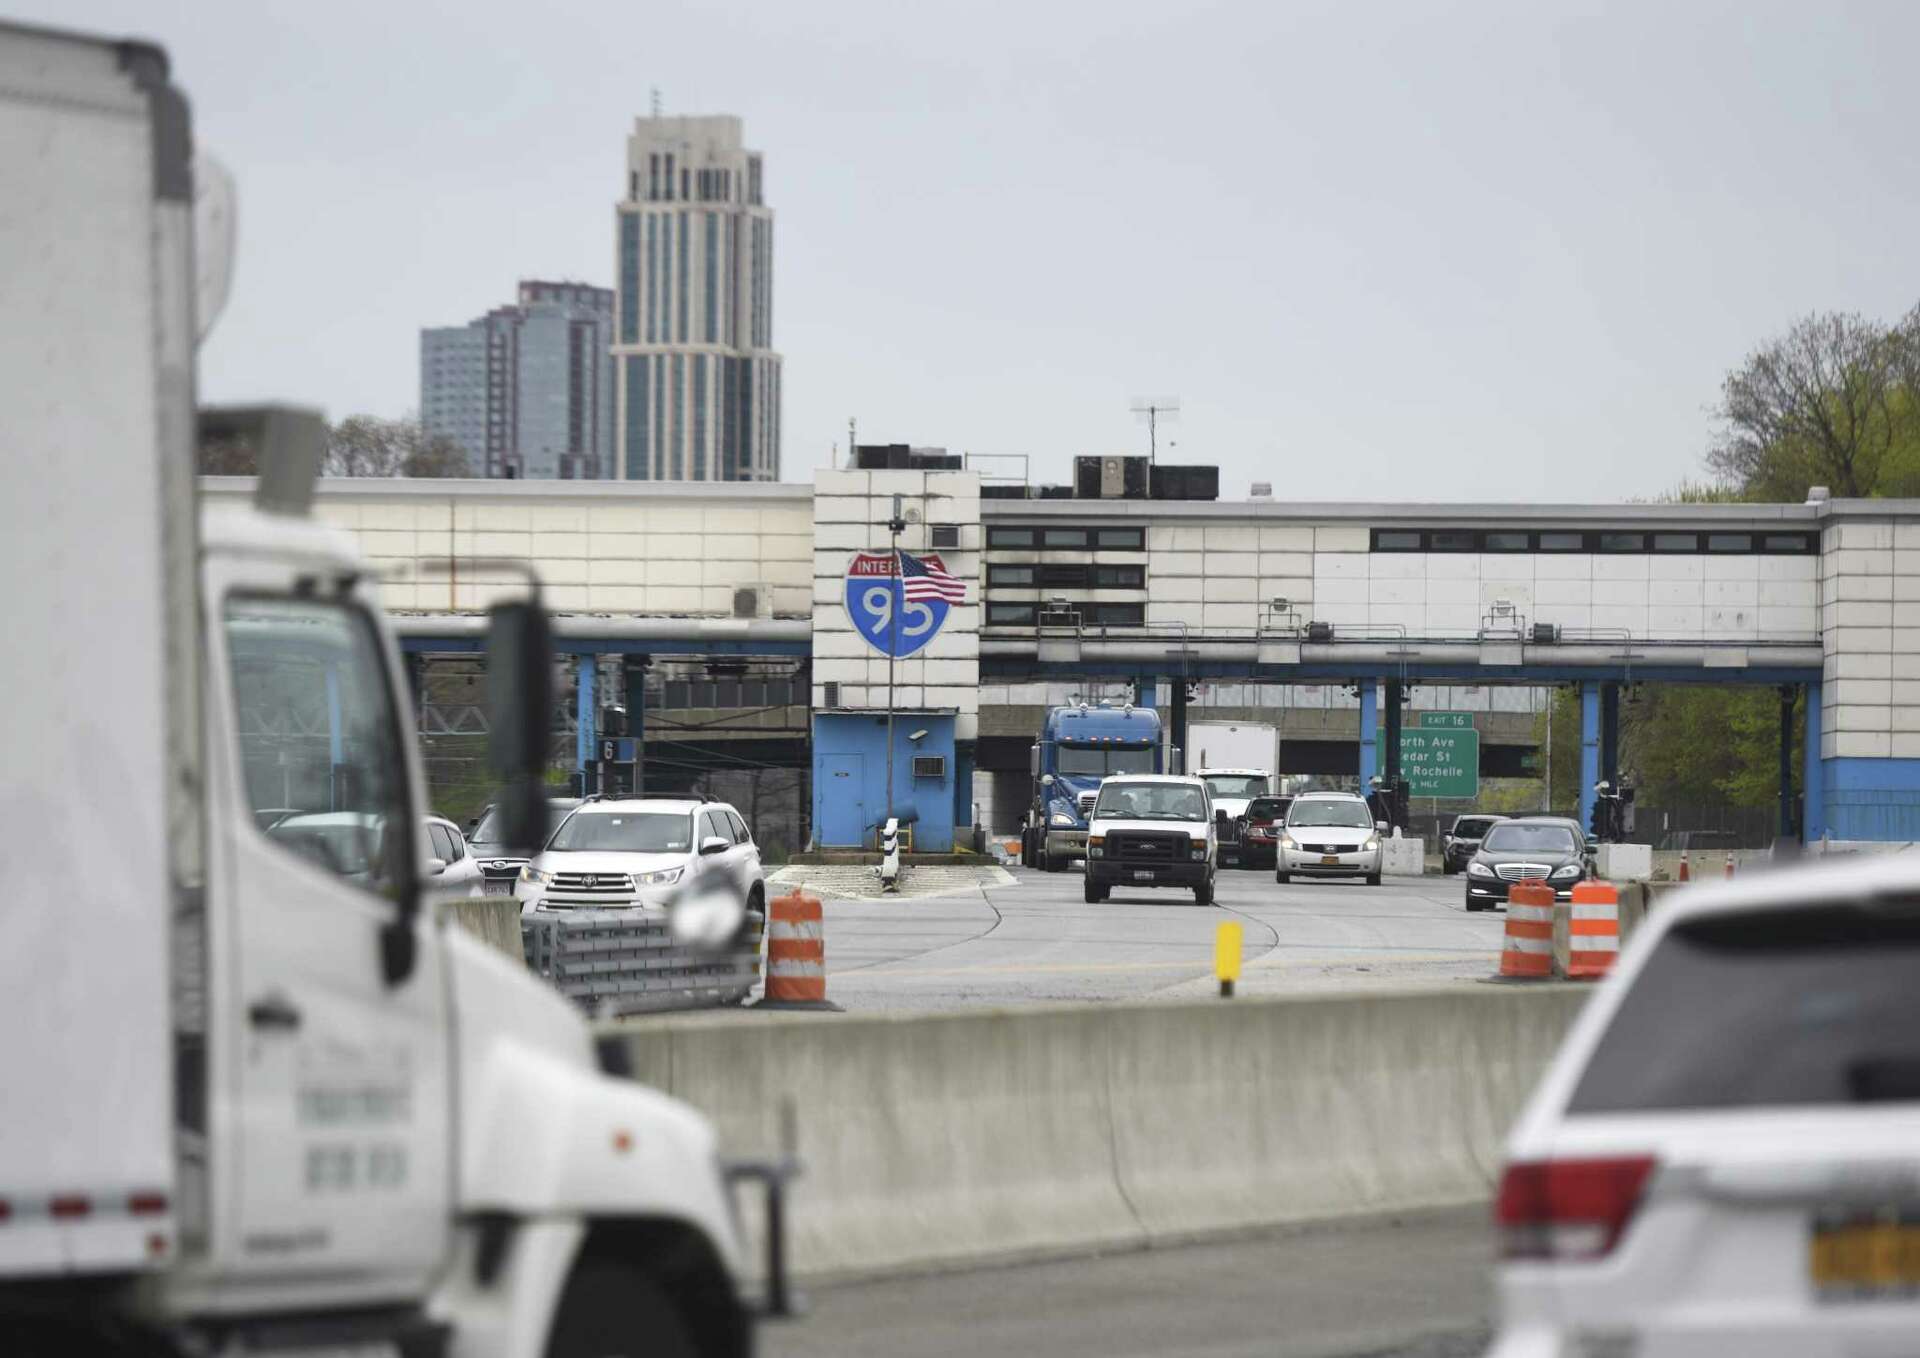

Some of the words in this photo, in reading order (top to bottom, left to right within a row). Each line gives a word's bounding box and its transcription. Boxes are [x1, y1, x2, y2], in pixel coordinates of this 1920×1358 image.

[862, 587, 933, 636] 95
[1453, 716, 1464, 726] 16
[1400, 737, 1425, 747] orth
[1432, 737, 1455, 747] Ave
[604, 741, 613, 760] 6
[1402, 752, 1429, 761] edar
[1437, 751, 1450, 761] St
[1413, 766, 1463, 777] Rochelle
